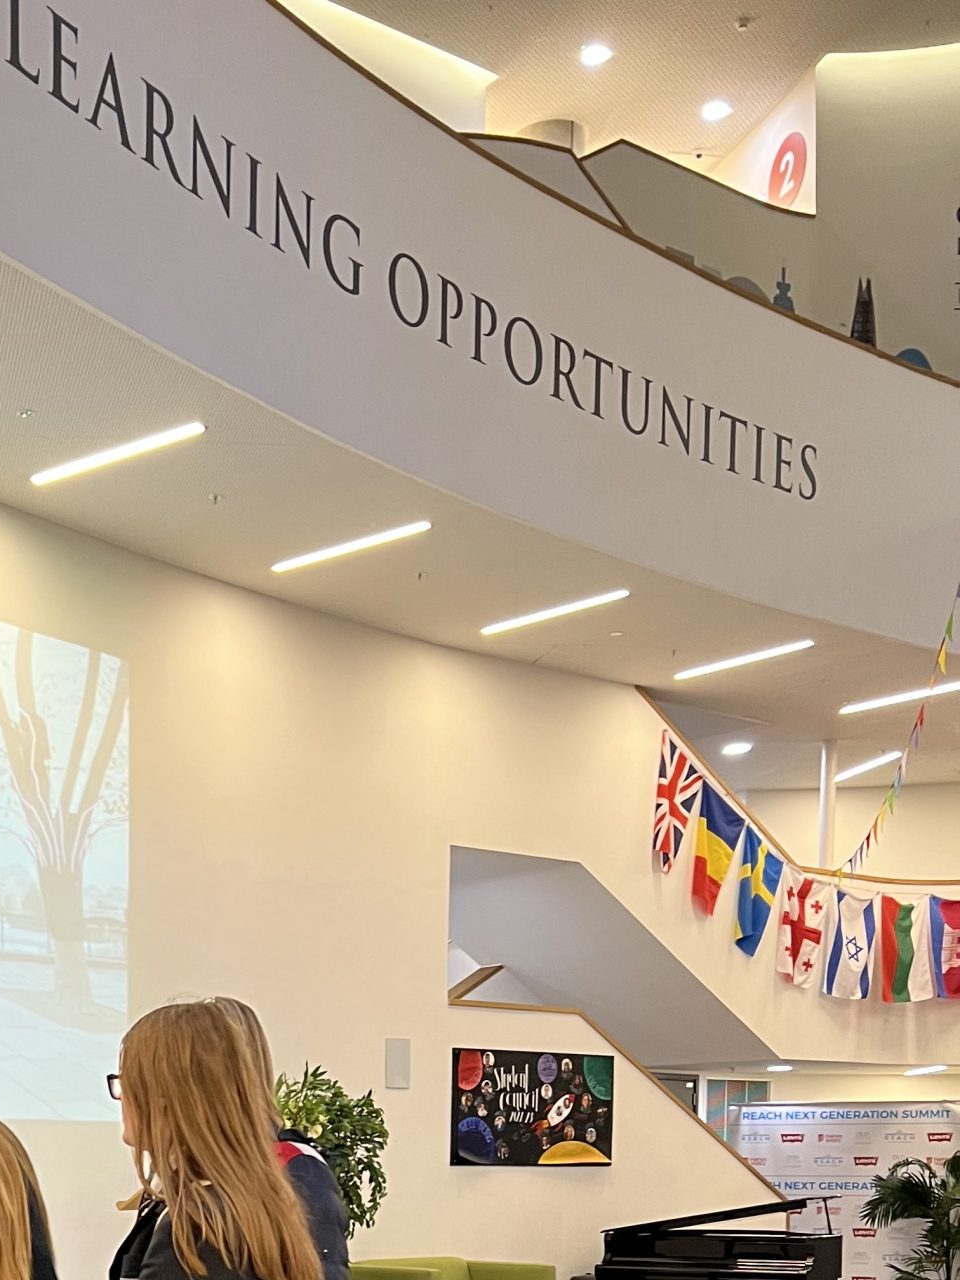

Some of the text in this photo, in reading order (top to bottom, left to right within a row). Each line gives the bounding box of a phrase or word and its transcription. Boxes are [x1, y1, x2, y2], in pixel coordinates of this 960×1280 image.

[779, 150, 795, 200] 2
[5, 0, 818, 501] LEARNING OPPORTUNITIES
[742, 1109, 951, 1121] REACH NEXT GENERATION SUMMIT
[784, 1181, 817, 1190] NEXT
[818, 1181, 878, 1191] GENERAT
